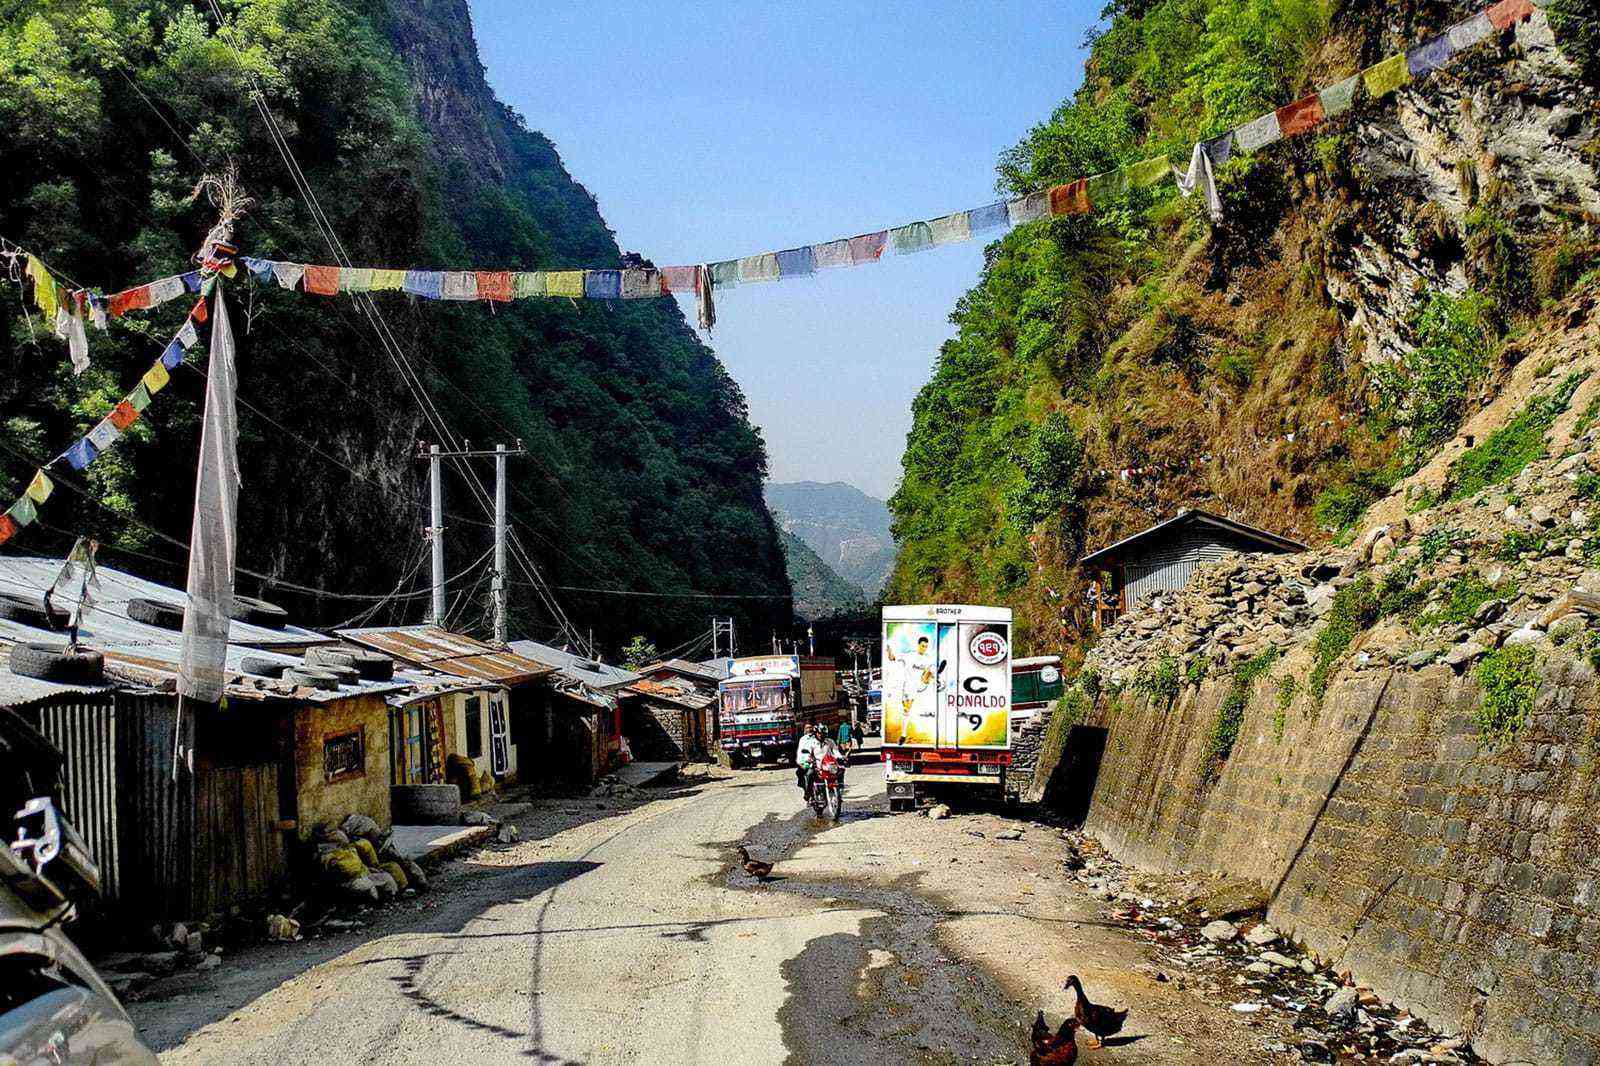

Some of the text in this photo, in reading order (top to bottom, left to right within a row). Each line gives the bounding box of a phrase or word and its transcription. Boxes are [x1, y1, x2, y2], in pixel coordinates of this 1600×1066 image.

[936, 607, 962, 615] BROTHER
[963, 676, 988, 693] C
[947, 694, 1006, 708] RONALDO
[969, 714, 982, 731] 9
